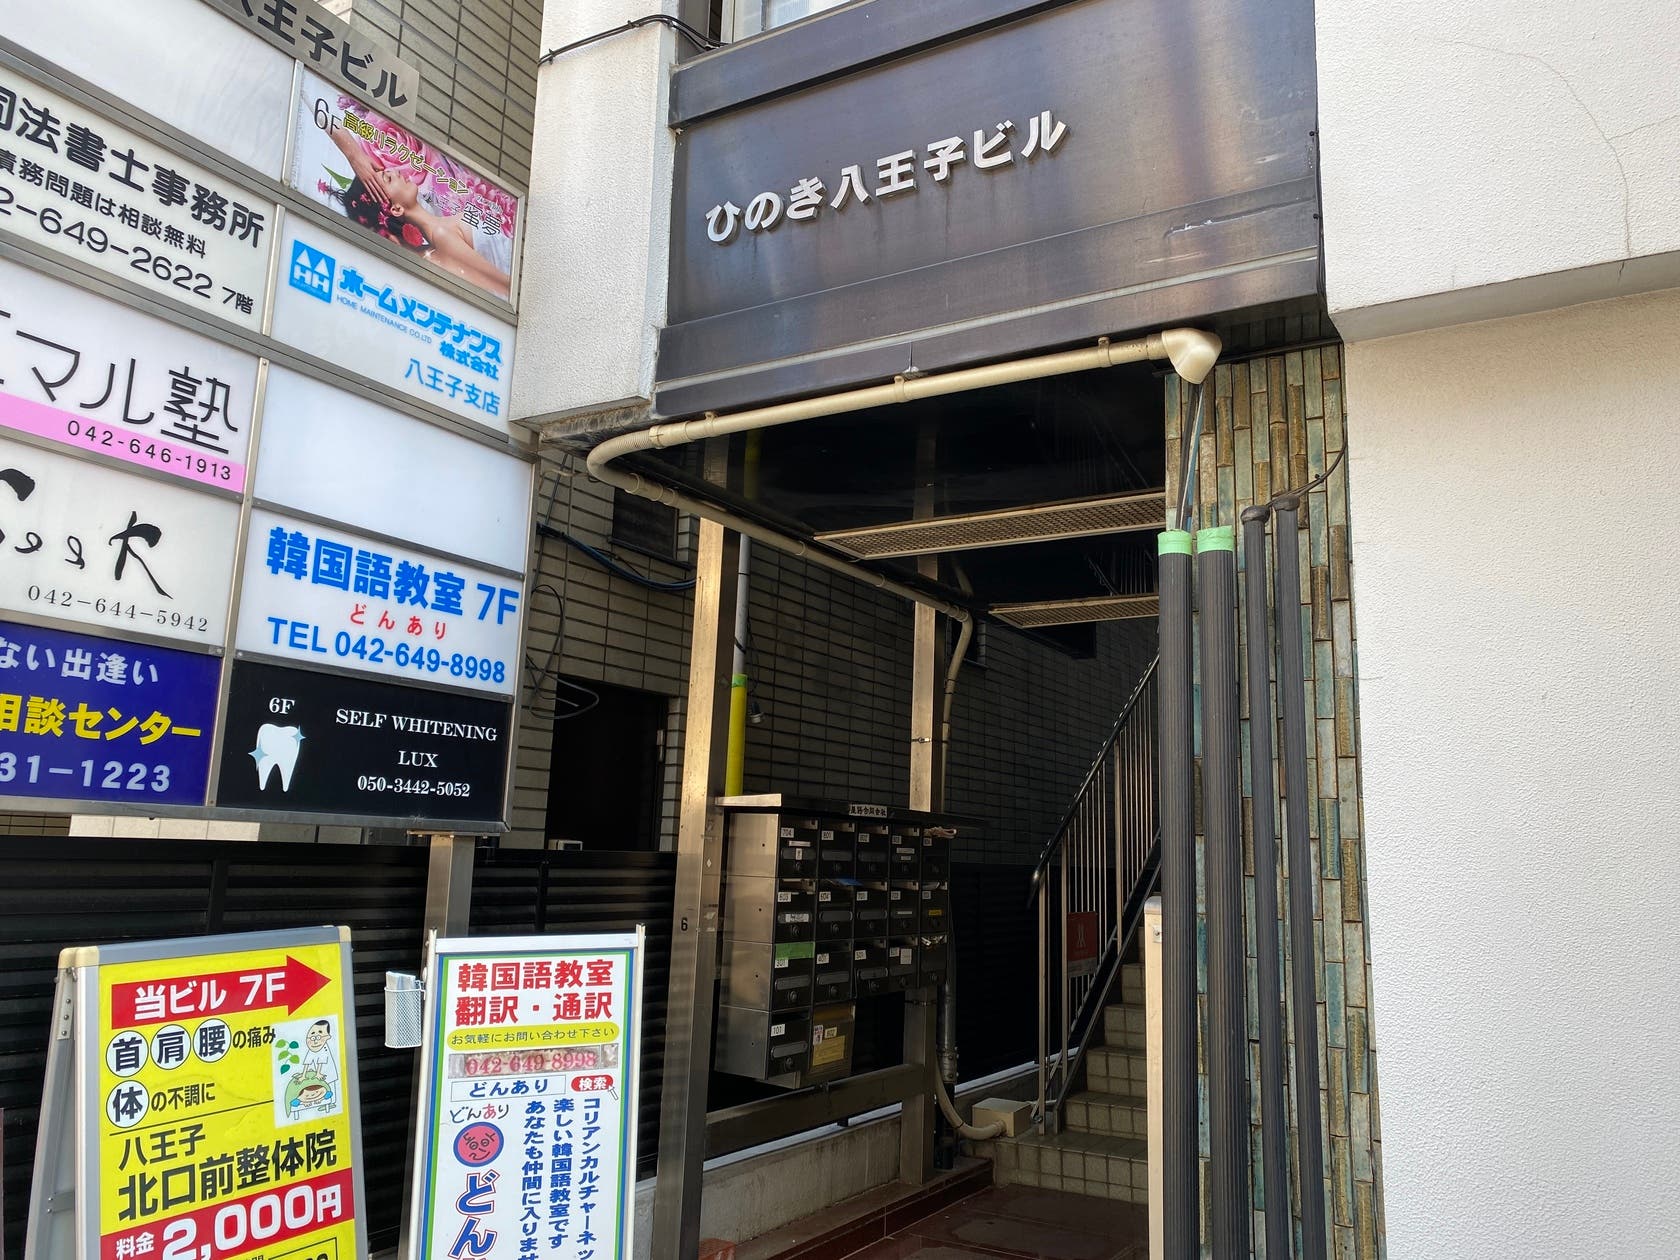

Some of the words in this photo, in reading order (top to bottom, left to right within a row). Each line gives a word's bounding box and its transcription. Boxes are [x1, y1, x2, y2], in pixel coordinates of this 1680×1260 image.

[314, 98, 341, 136] 6F
[705, 110, 1068, 245] ひのき八王子ビル
[222, 286, 254, 314] 7階
[339, 267, 503, 364] ホームメンテナンス
[439, 340, 499, 381] 株式会社
[0, 309, 238, 454] マル塾
[405, 358, 500, 416] 八王子支店
[67, 420, 231, 480] 042-646-1913
[266, 526, 465, 616] 韓国語教室
[476, 583, 520, 625] 7F
[28, 585, 208, 632] 042-644-5942
[350, 603, 446, 640] どんあり
[267, 616, 327, 653] TEL
[335, 631, 505, 684] 042-649-8998
[269, 697, 295, 715] 6F
[335, 708, 387, 728] SELF
[391, 715, 497, 741] WHITENING
[398, 750, 438, 768] LUX
[357, 775, 470, 797] 050-3442-5052
[680, 917, 688, 931] 6
[457, 959, 614, 992] 韓国語教室
[133, 980, 226, 1021] 当ビル
[239, 971, 286, 1006] 7F
[455, 992, 613, 1026] 翻訳・通訳
[451, 1028, 615, 1045] お気軽にお問い合わせ下さい
[465, 1050, 598, 1076] 042-649-8998
[469, 1078, 548, 1097] どんあり
[578, 1077, 608, 1092] 検索
[449, 1103, 509, 1124] どんあり
[118, 1123, 206, 1171] 八王子
[118, 1128, 337, 1221] 北口前整体院
[548, 1098, 575, 1249] 楽しい韓国語教室です
[448, 1169, 500, 1260] どん
[116, 1231, 155, 1259] 料金
